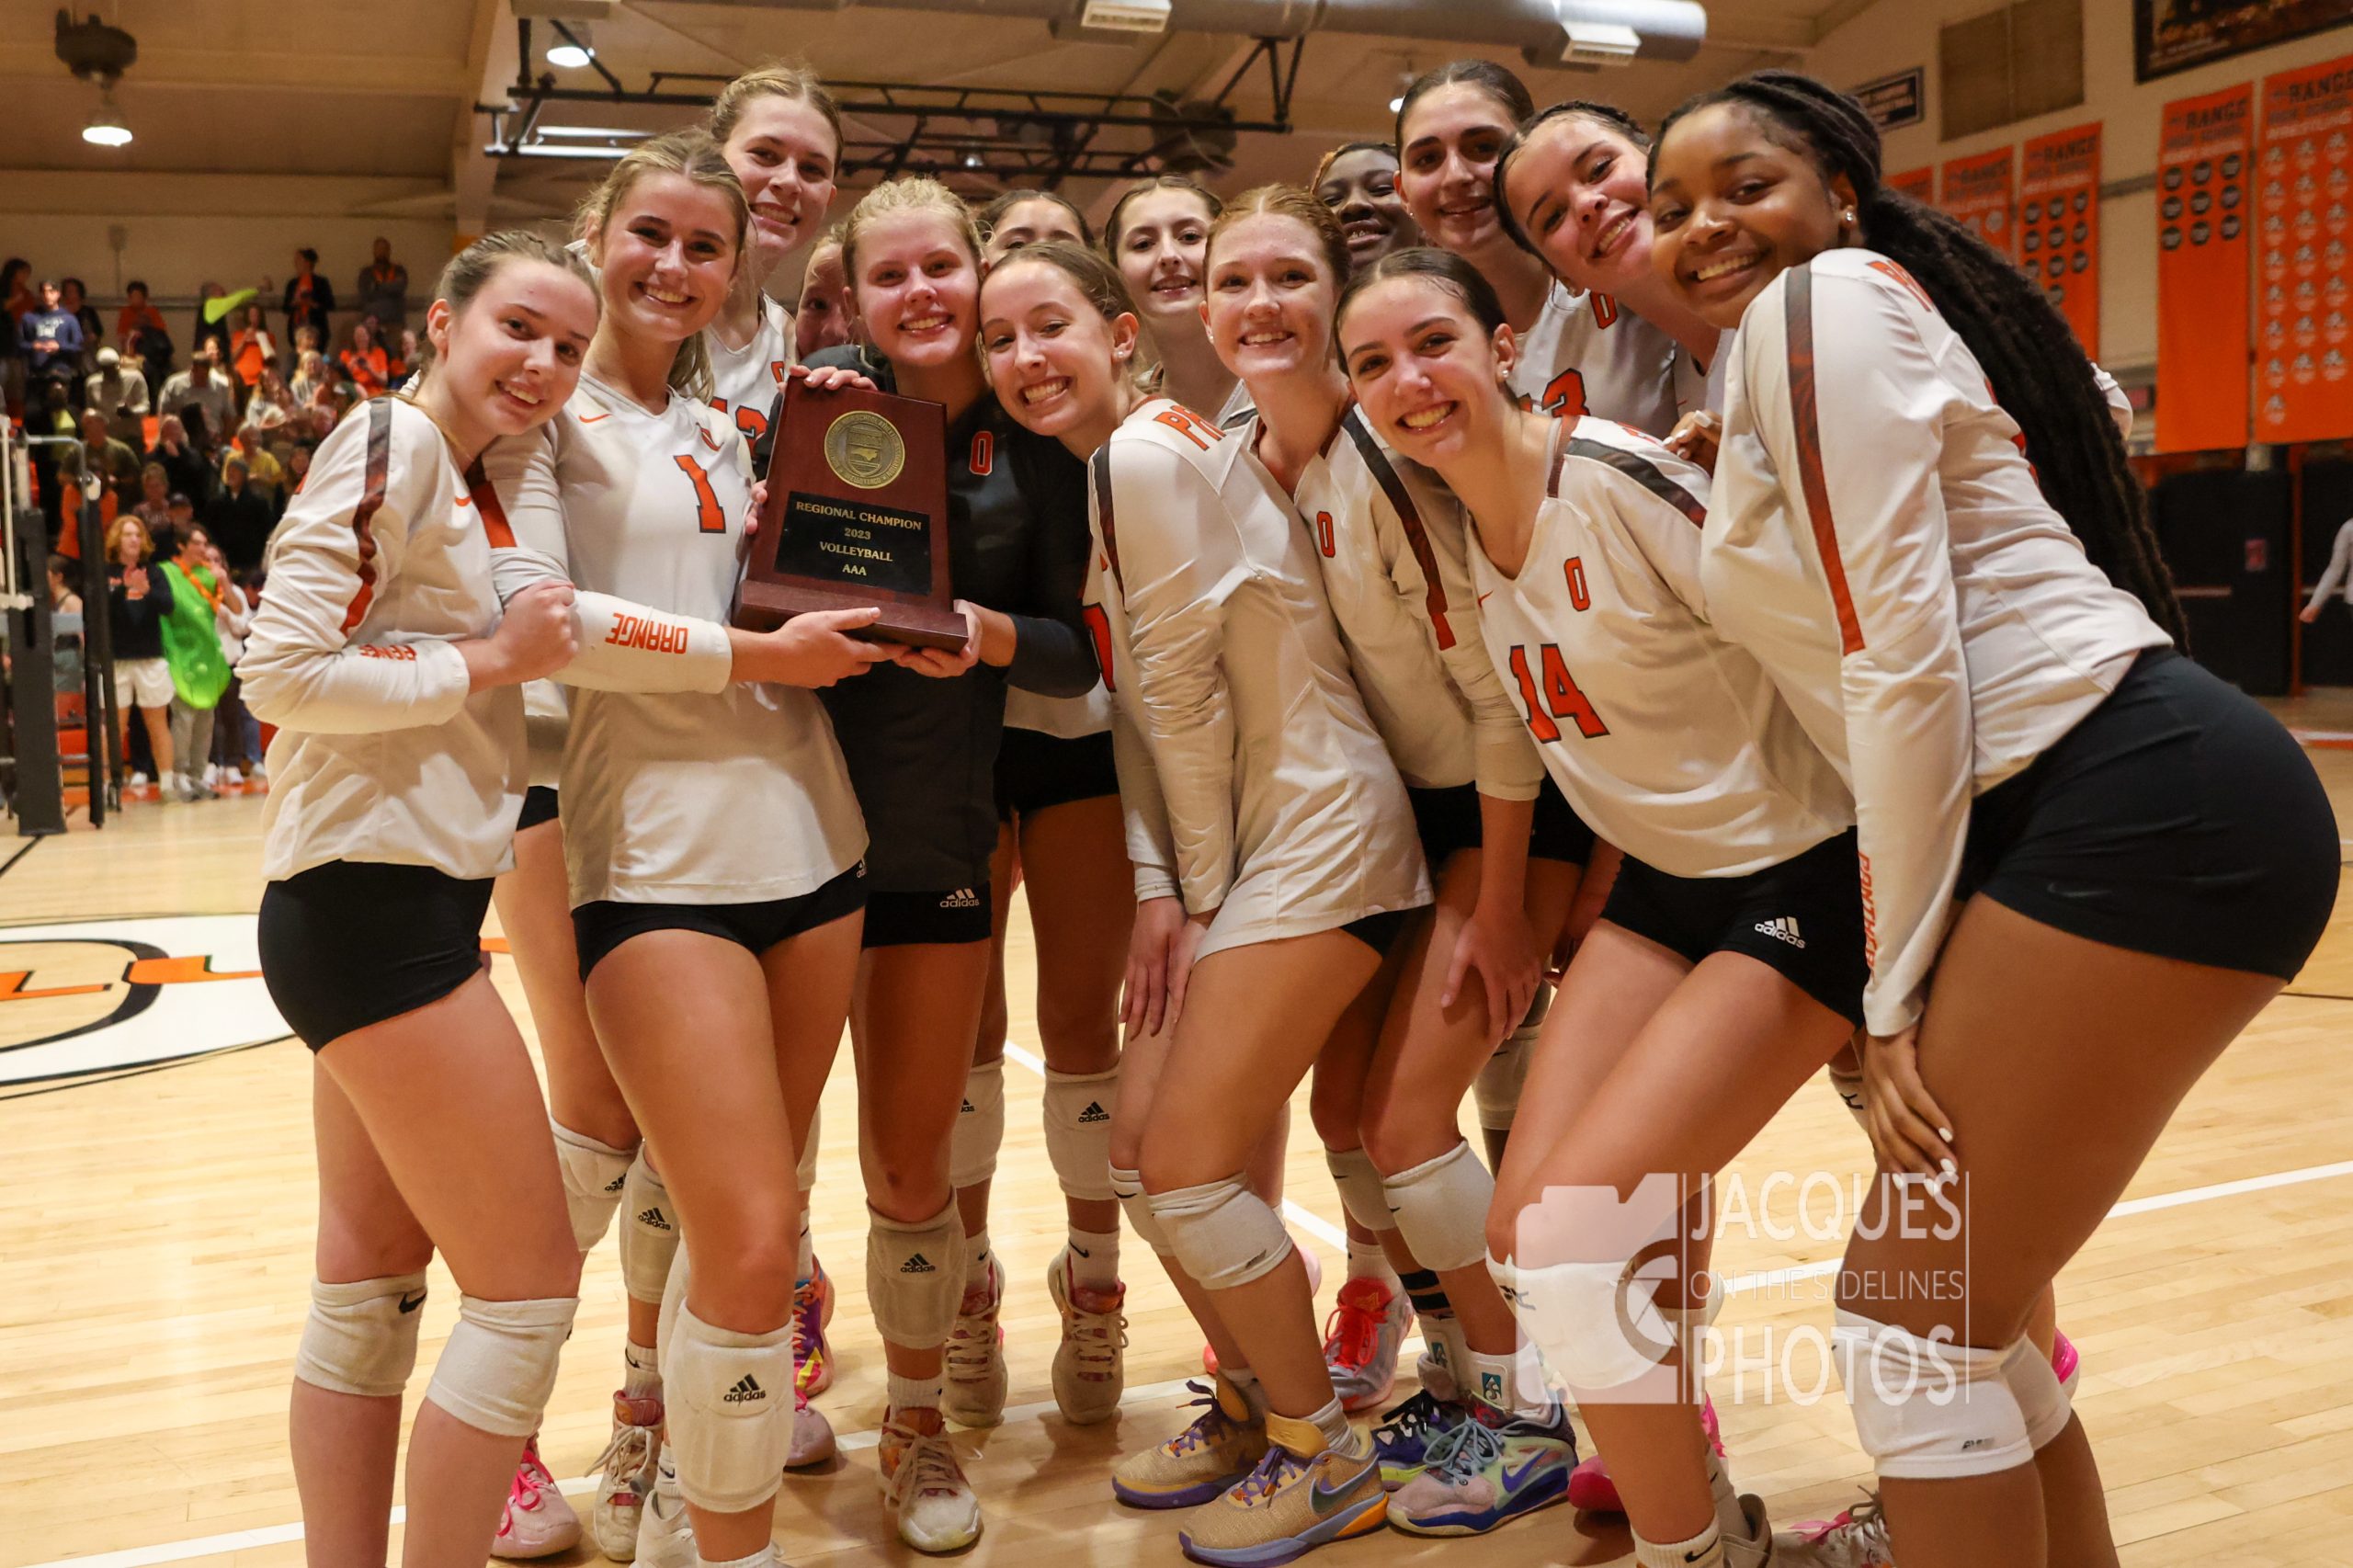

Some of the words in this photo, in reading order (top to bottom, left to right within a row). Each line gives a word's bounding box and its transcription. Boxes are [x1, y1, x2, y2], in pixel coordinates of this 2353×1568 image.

[969, 430, 994, 476] O
[673, 454, 726, 534] 1
[796, 501, 856, 520] REGIONAL
[858, 512, 922, 531] CHAMPION
[844, 528, 871, 540] 2023
[1317, 510, 1336, 558] O
[819, 540, 893, 562] VOLLEYBALL
[841, 563, 868, 576] AAA
[1564, 556, 1591, 612] O
[604, 612, 689, 654] ORANGE
[1509, 642, 1610, 744] 14
[939, 897, 980, 908] adidas
[1754, 923, 1806, 949] adidas
[638, 1214, 671, 1231] adidas
[723, 1391, 767, 1403] adidas
